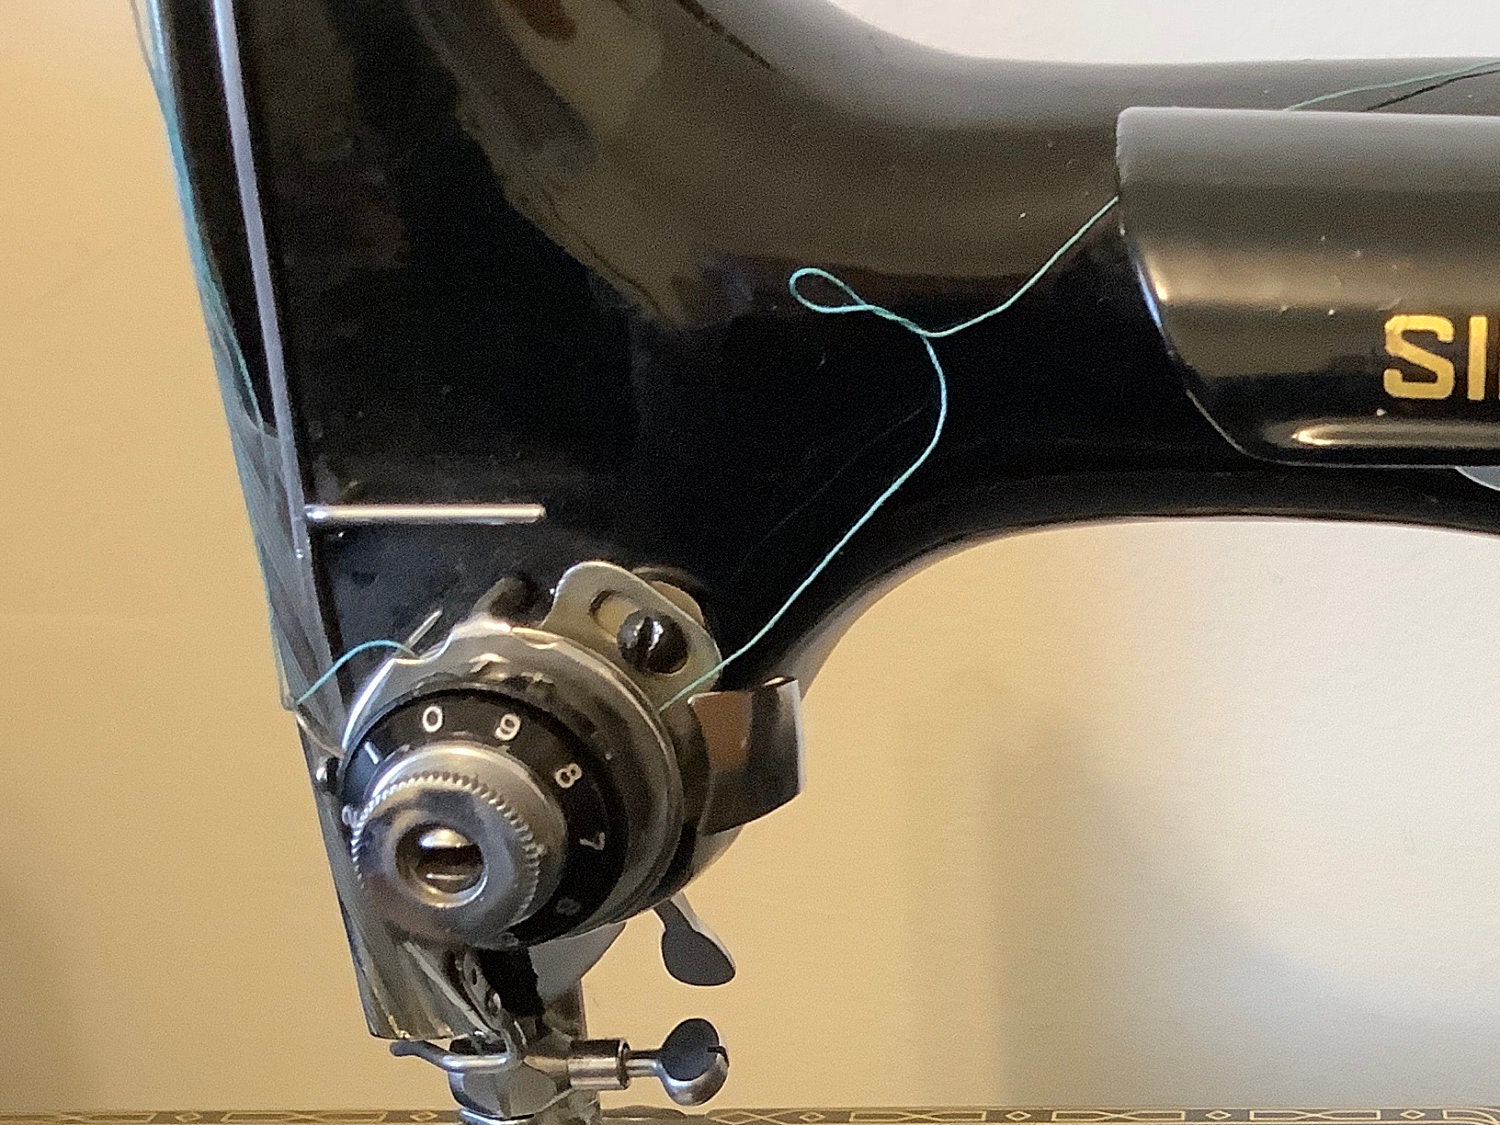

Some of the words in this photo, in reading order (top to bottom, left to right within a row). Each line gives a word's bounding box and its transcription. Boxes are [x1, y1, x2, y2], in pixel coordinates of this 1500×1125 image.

[422, 705, 443, 733] 0
[494, 713, 521, 741] 9
[555, 762, 582, 788] 8
